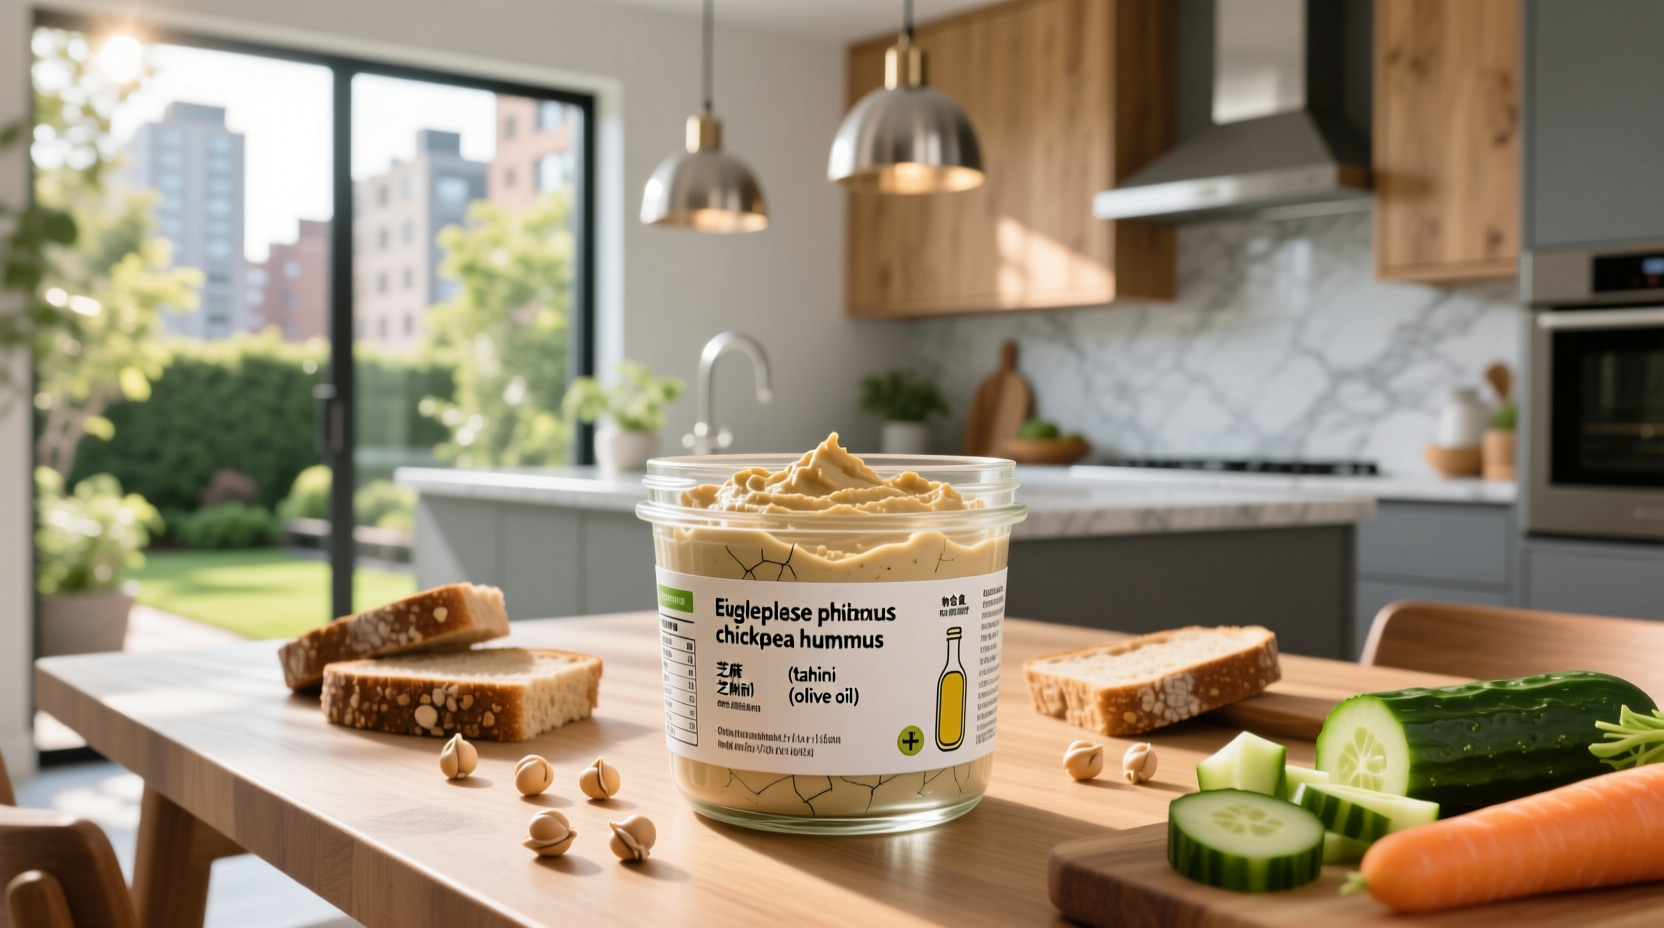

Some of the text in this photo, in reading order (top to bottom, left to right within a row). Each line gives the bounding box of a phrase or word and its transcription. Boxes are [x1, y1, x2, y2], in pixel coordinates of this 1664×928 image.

[715, 624, 795, 651] chickpea
[800, 626, 883, 649] hummus
[788, 665, 836, 684] (tahini
[788, 686, 860, 707] (olive oil)
